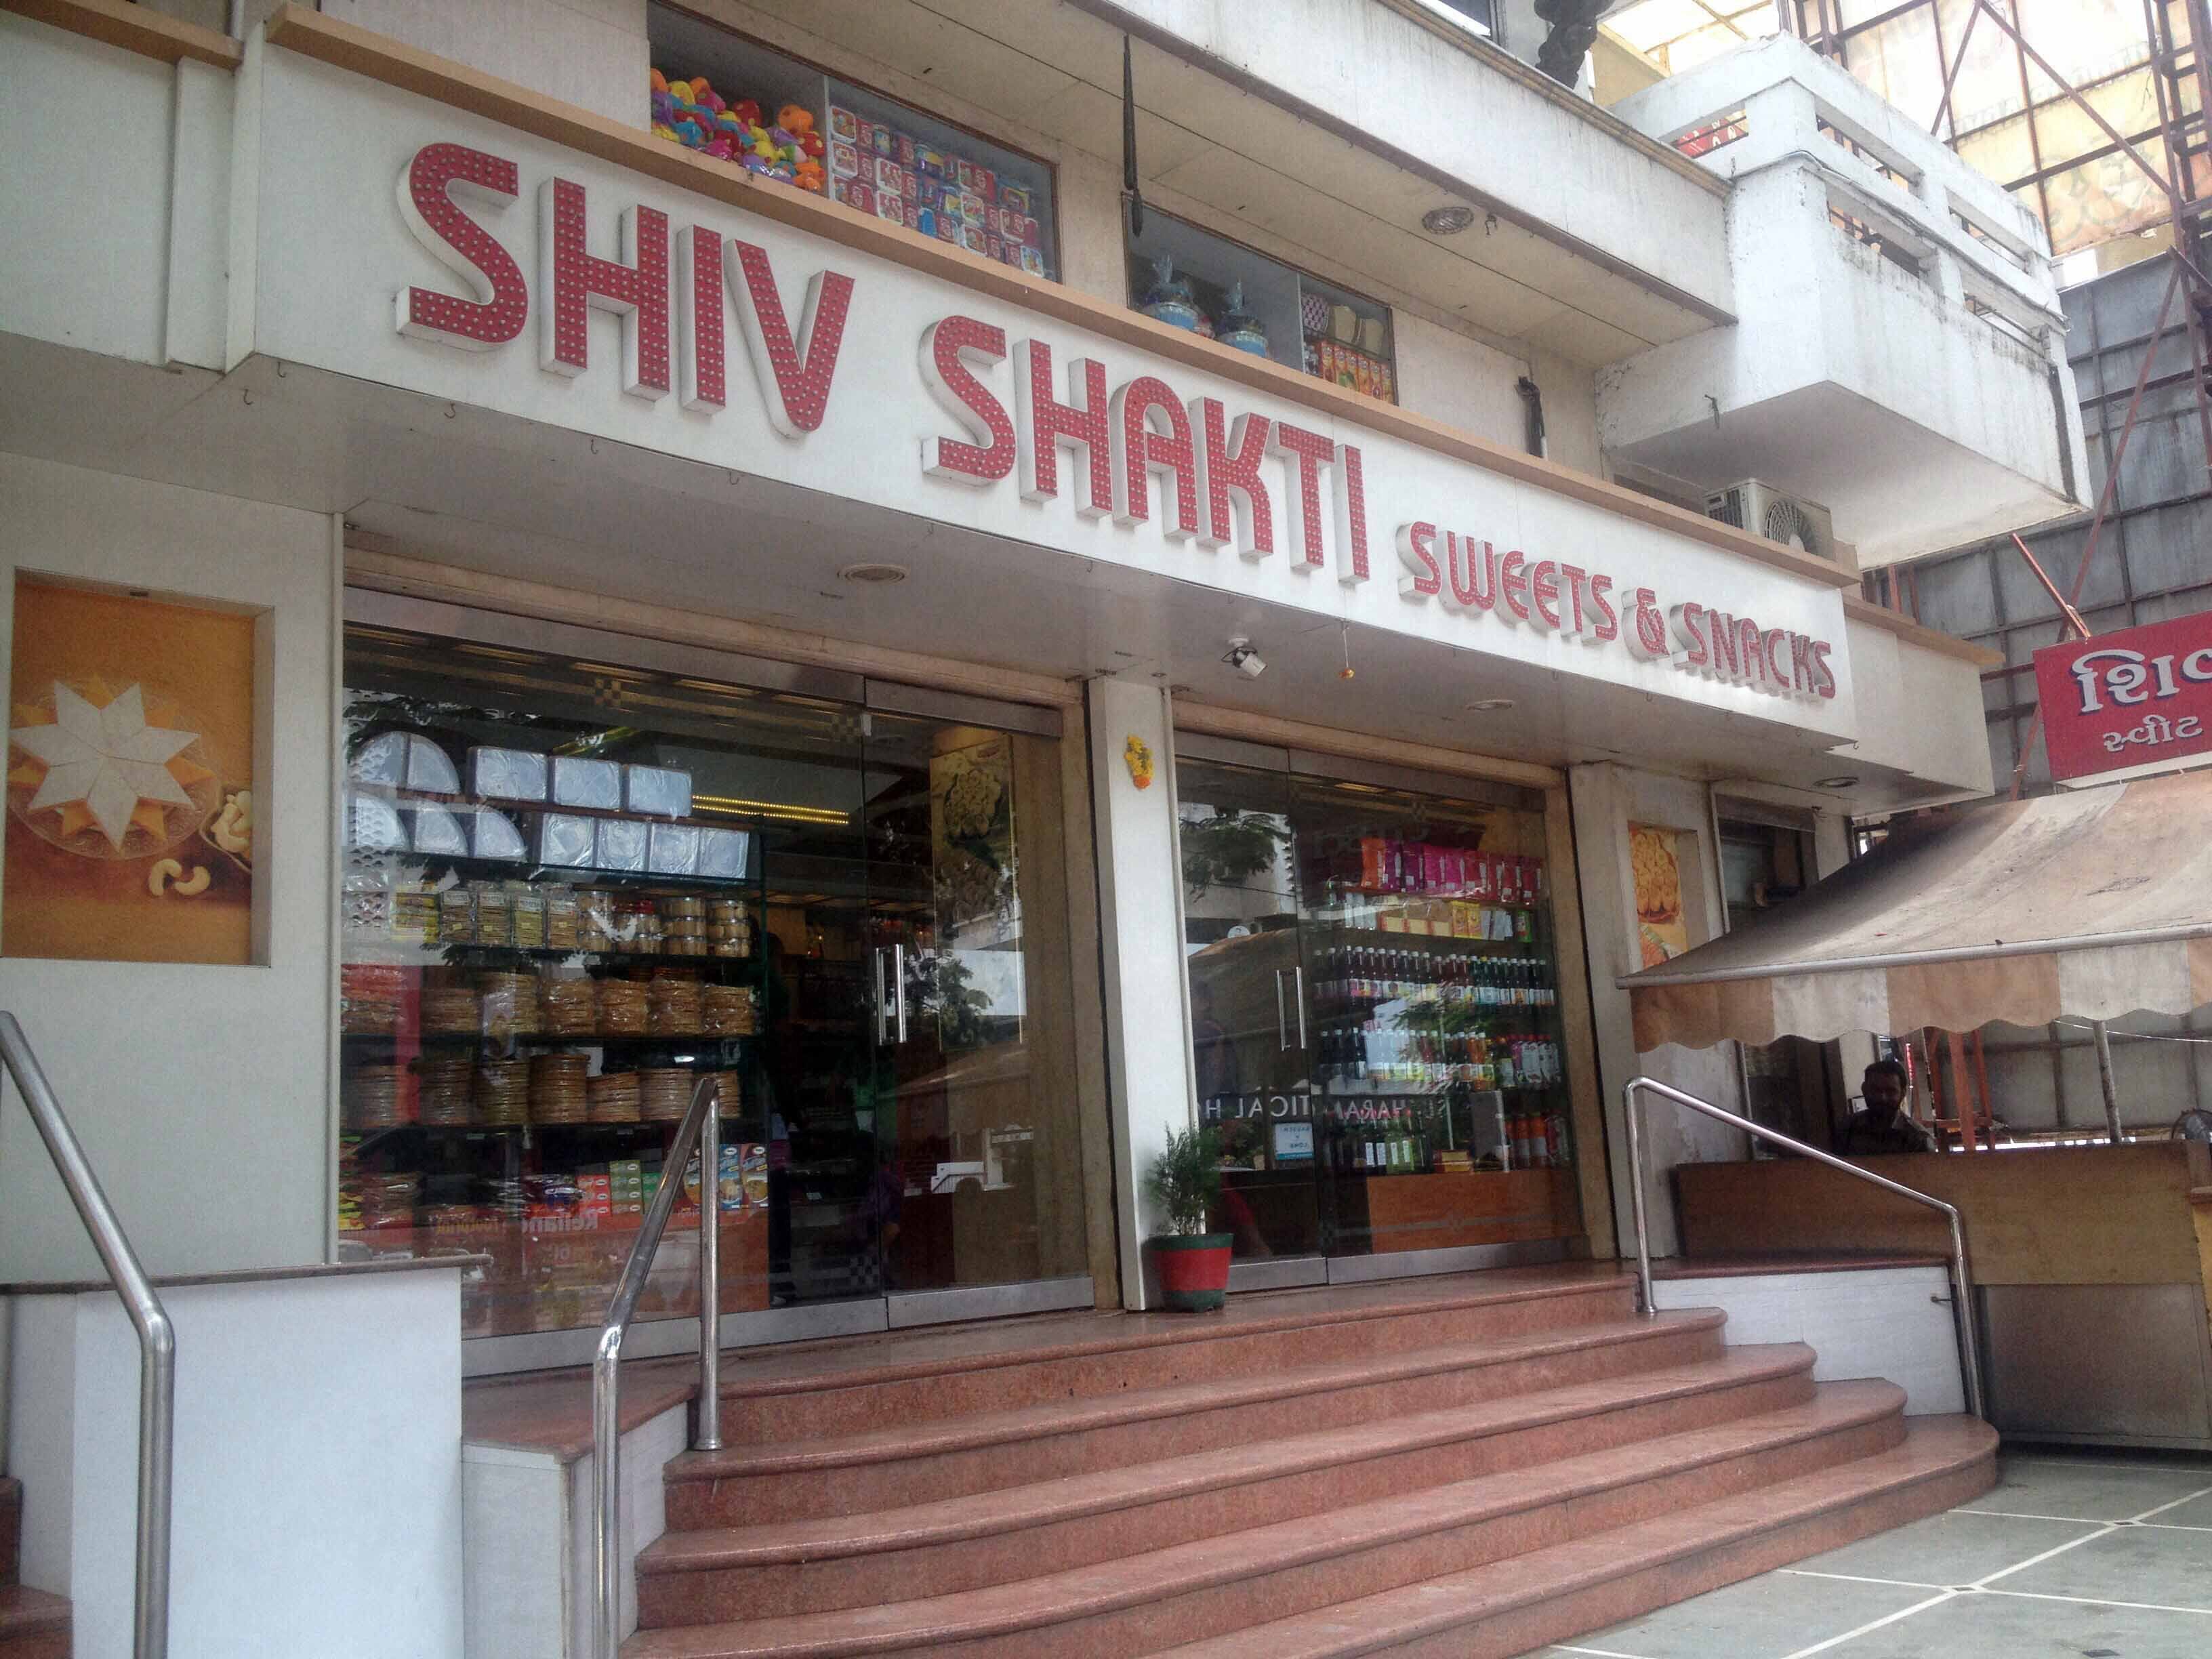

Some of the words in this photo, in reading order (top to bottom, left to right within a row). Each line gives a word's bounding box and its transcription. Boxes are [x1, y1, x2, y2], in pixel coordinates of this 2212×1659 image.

[396, 142, 855, 438] SHIV
[920, 314, 1370, 584] SHAKTI
[1396, 520, 1618, 646] SWEETS
[1622, 587, 1670, 662] &
[1671, 602, 1837, 699] SNACKS
